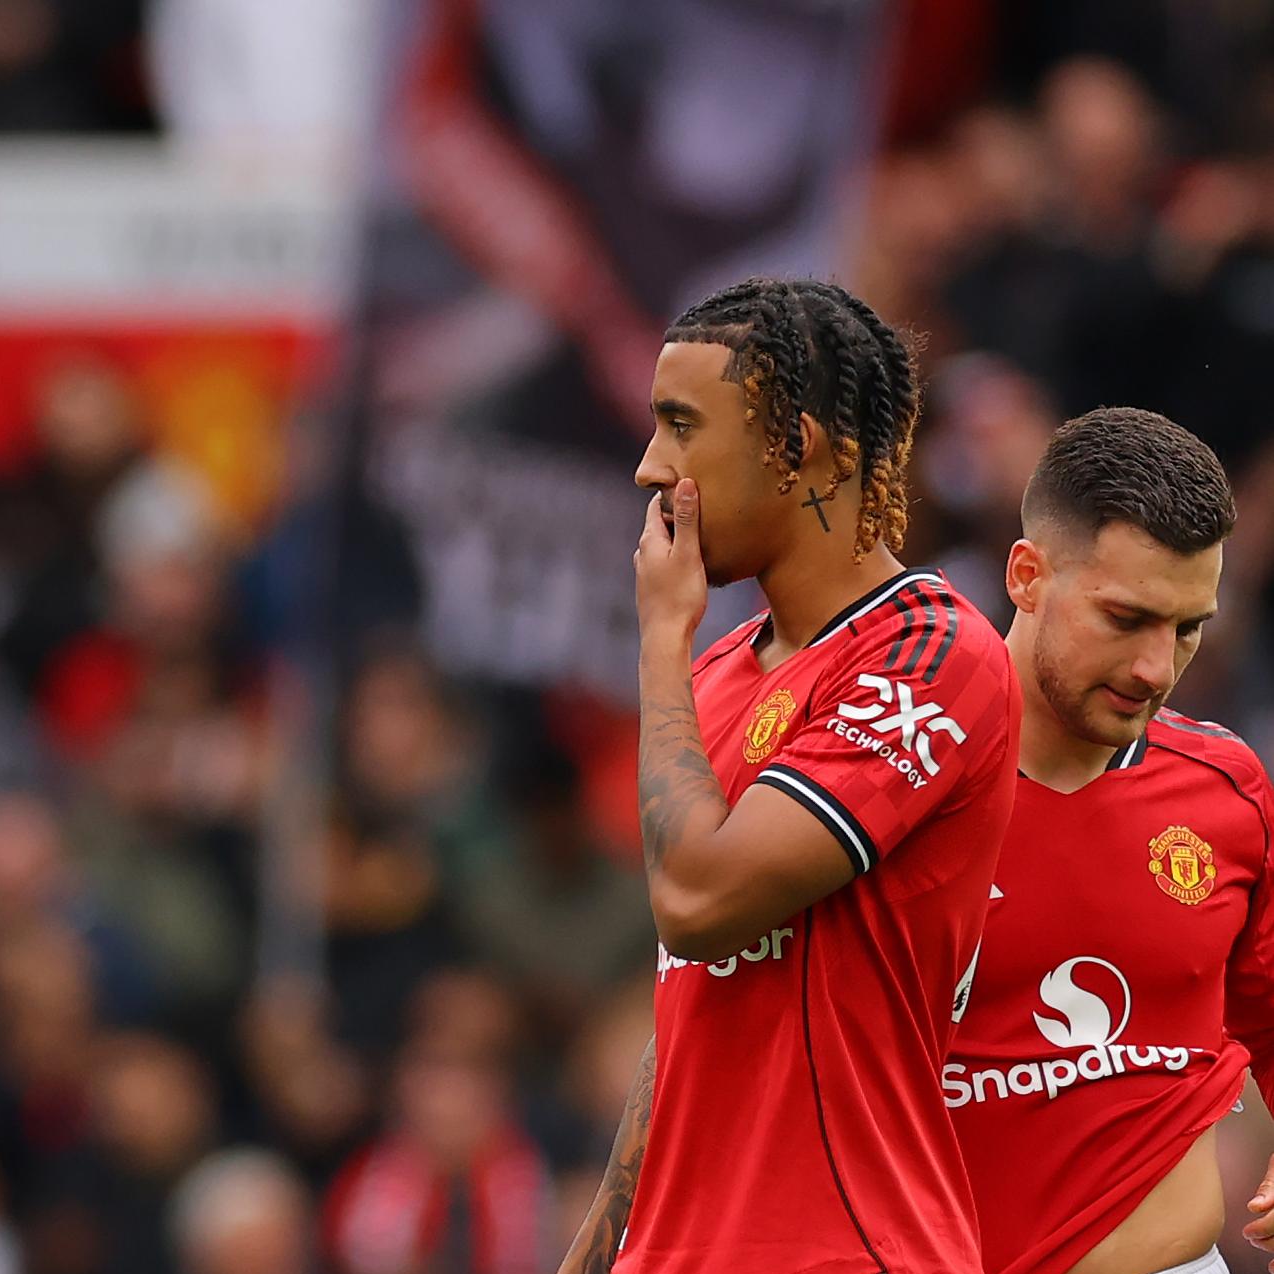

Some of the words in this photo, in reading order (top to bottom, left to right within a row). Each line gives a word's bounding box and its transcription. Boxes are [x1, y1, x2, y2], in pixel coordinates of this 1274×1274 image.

[837, 673, 968, 777] DXC
[826, 718, 927, 790] TECHNOLOGY
[1155, 831, 1210, 860] MANCHESTER
[1169, 884, 1206, 899] UNITED
